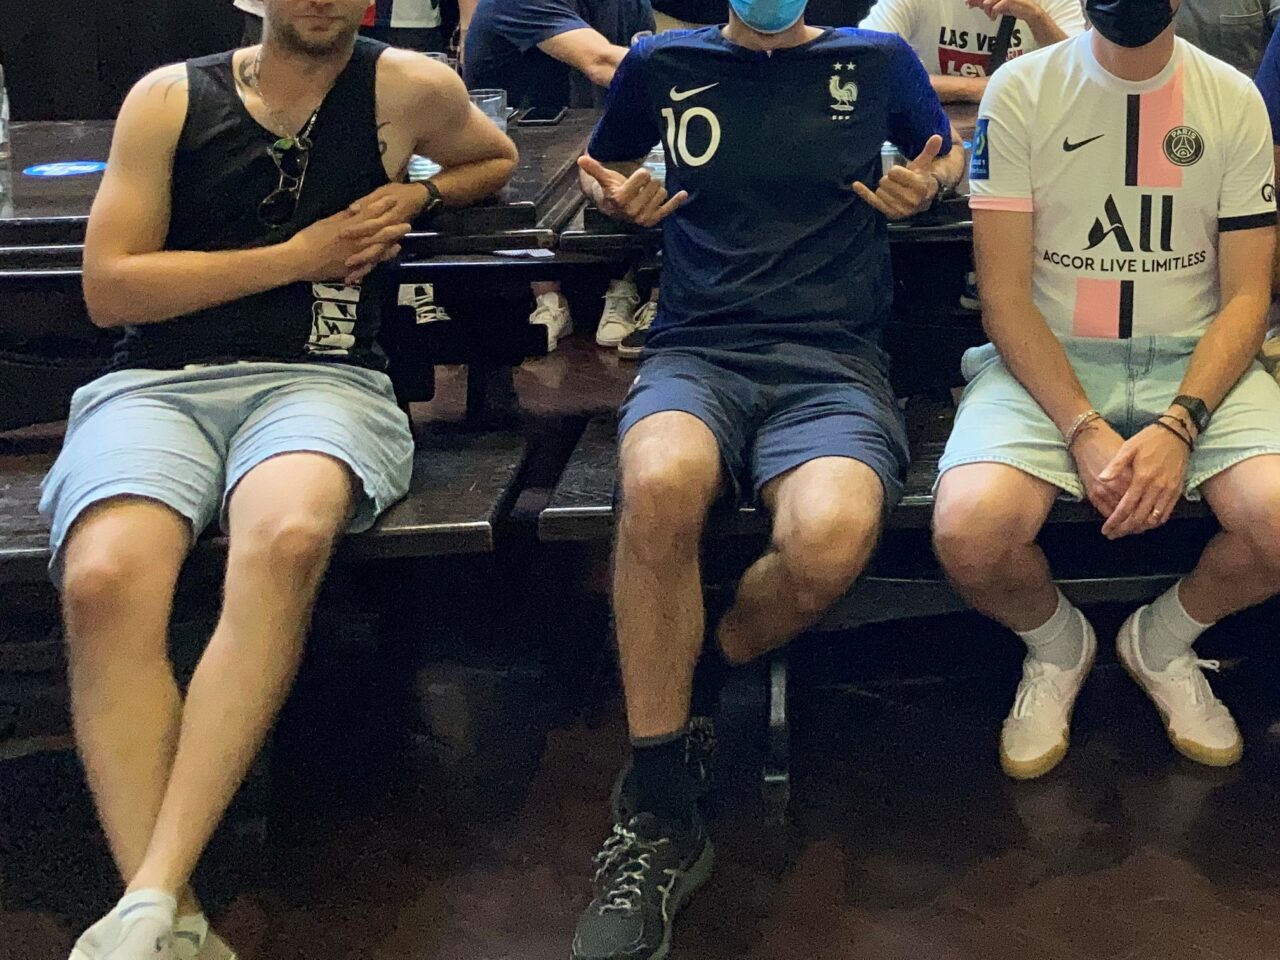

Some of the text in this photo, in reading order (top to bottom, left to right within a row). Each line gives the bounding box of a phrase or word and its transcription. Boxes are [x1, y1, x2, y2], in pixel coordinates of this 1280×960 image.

[939, 26, 969, 49] LAS
[661, 106, 721, 168] 10
[1171, 128, 1197, 139] PARIS
[1042, 249, 1207, 273] ACCOR LIVE LIMITLESS
